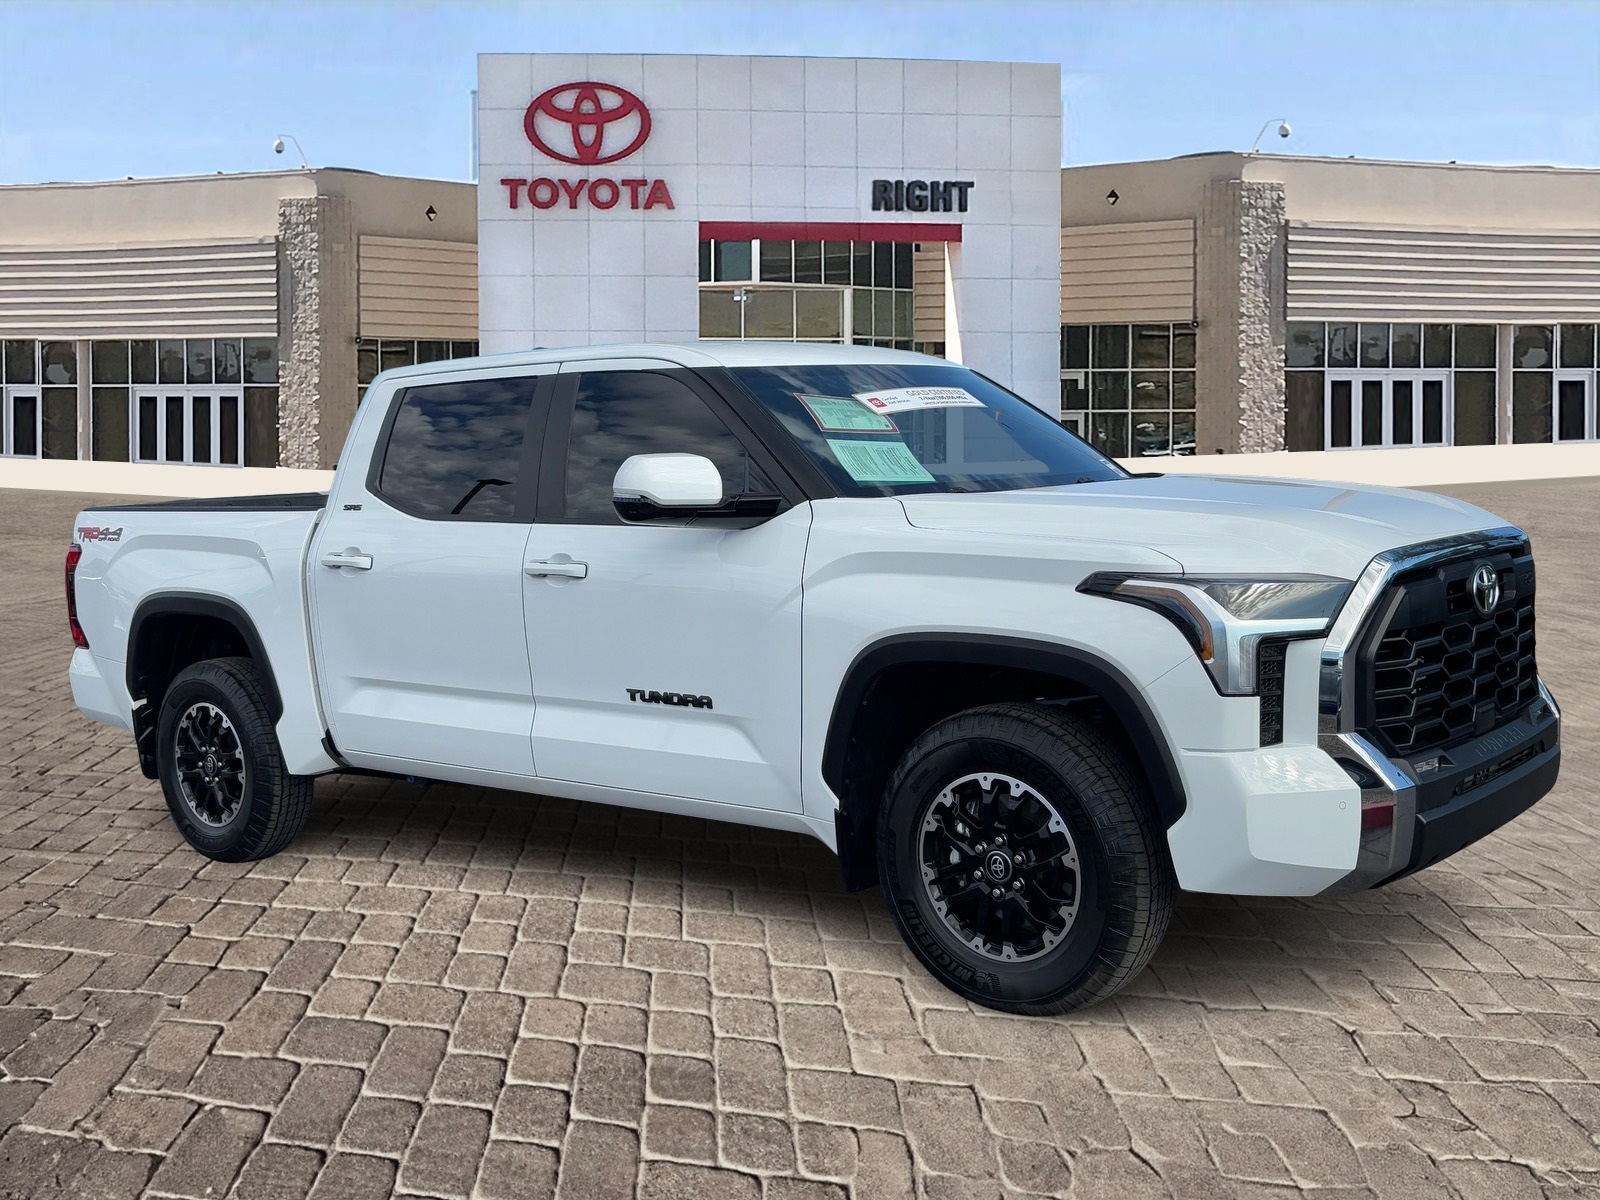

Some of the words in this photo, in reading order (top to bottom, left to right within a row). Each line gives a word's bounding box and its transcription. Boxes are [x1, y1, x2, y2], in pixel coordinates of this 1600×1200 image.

[500, 178, 675, 210] TOYOTA
[872, 179, 974, 212] RIGHT
[625, 688, 713, 709] TUNDRA
[900, 900, 975, 983] MICHELIN
